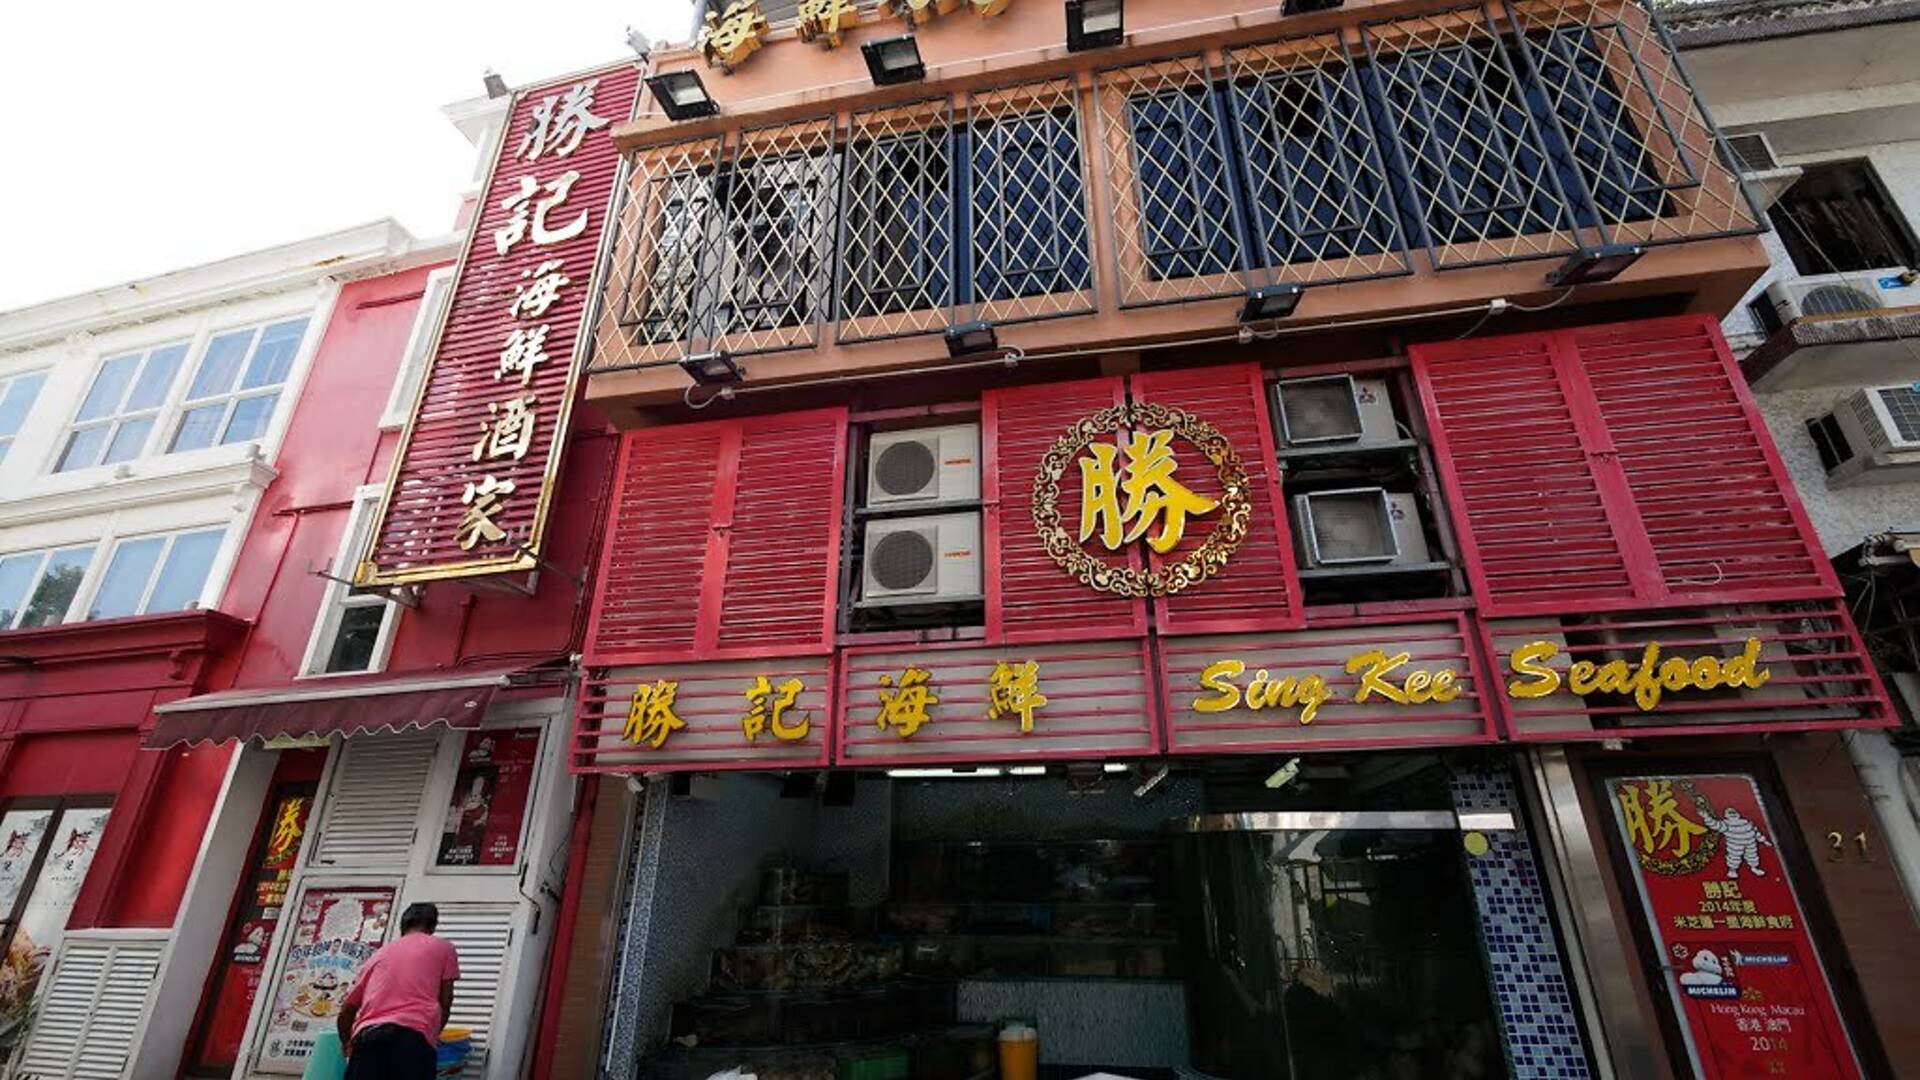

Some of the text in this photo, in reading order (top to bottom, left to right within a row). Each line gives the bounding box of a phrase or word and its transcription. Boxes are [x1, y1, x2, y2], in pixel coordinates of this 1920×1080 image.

[452, 78, 610, 552] 勝記海鮮酒家
[1079, 428, 1221, 554] 勝
[1193, 649, 1464, 725] Sing Kee
[1508, 637, 1771, 712] Seafood
[1619, 778, 1707, 859] 勝
